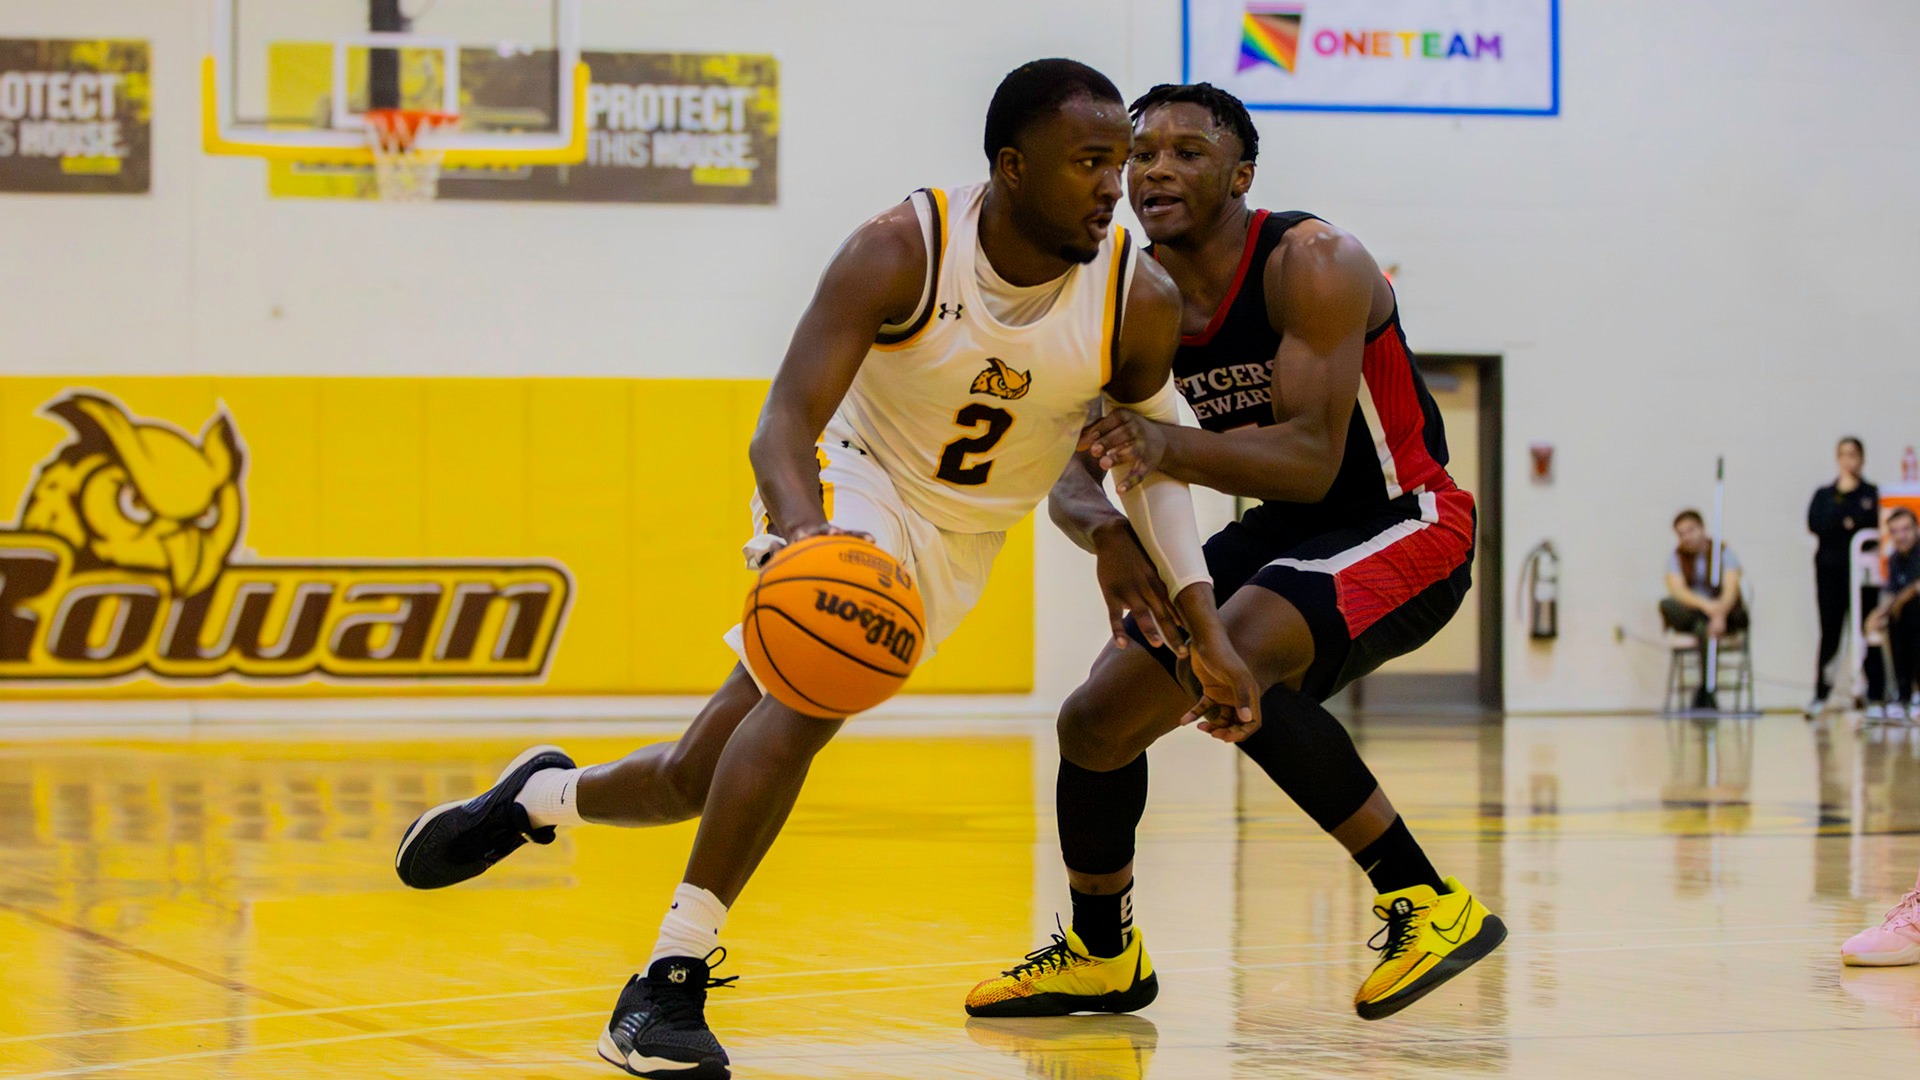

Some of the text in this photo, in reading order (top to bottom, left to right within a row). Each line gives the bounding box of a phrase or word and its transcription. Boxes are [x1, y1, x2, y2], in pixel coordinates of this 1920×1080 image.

[1313, 30, 1503, 60] ONETEAM
[587, 83, 752, 132] PROTECT
[587, 130, 650, 168] THIS
[932, 401, 1016, 486] 2
[814, 587, 917, 666] Wilson
